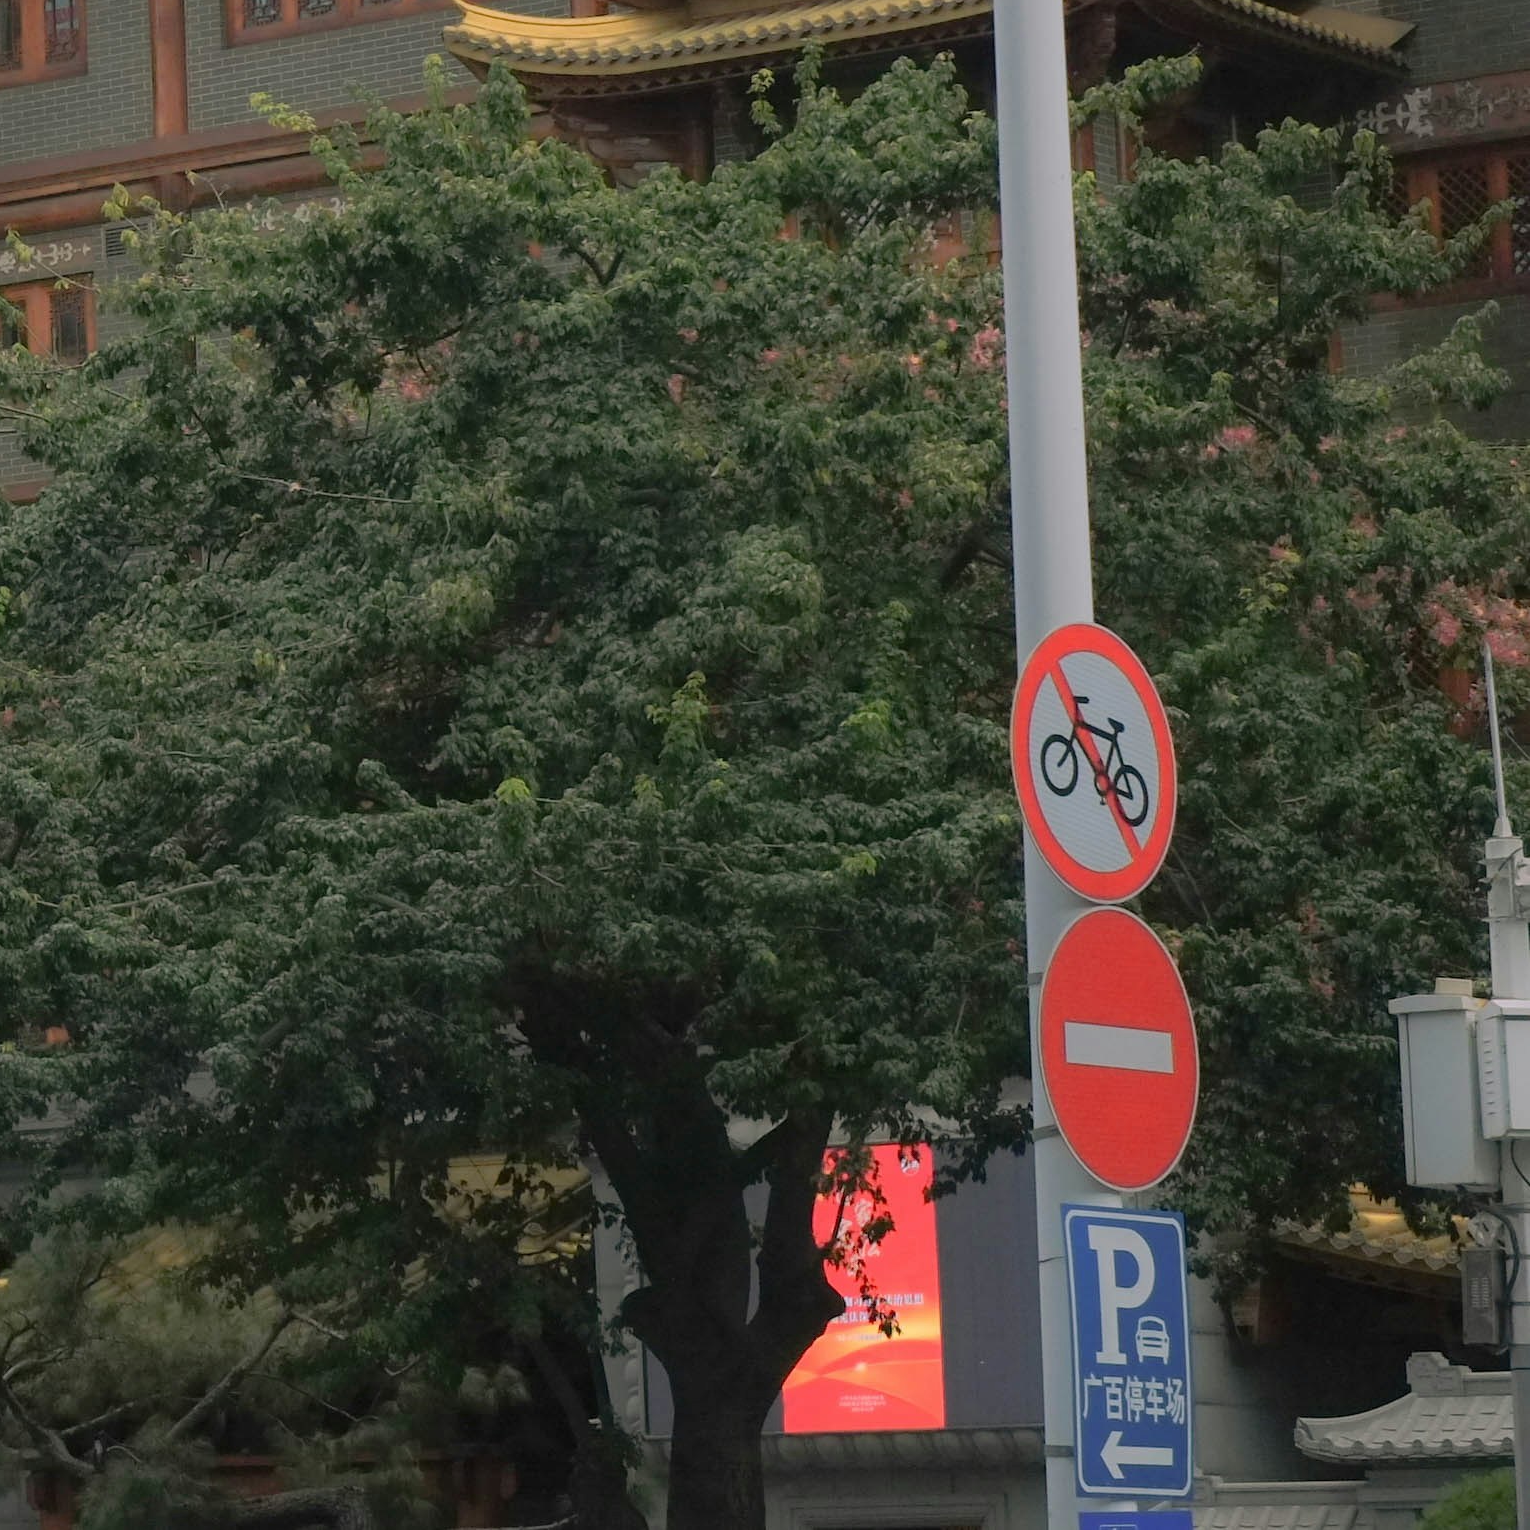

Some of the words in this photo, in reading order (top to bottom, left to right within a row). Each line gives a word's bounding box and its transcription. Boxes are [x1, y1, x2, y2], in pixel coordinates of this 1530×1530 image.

[1088, 1224, 1155, 1365] P
[1083, 1373, 1186, 1425] 广百停车场
